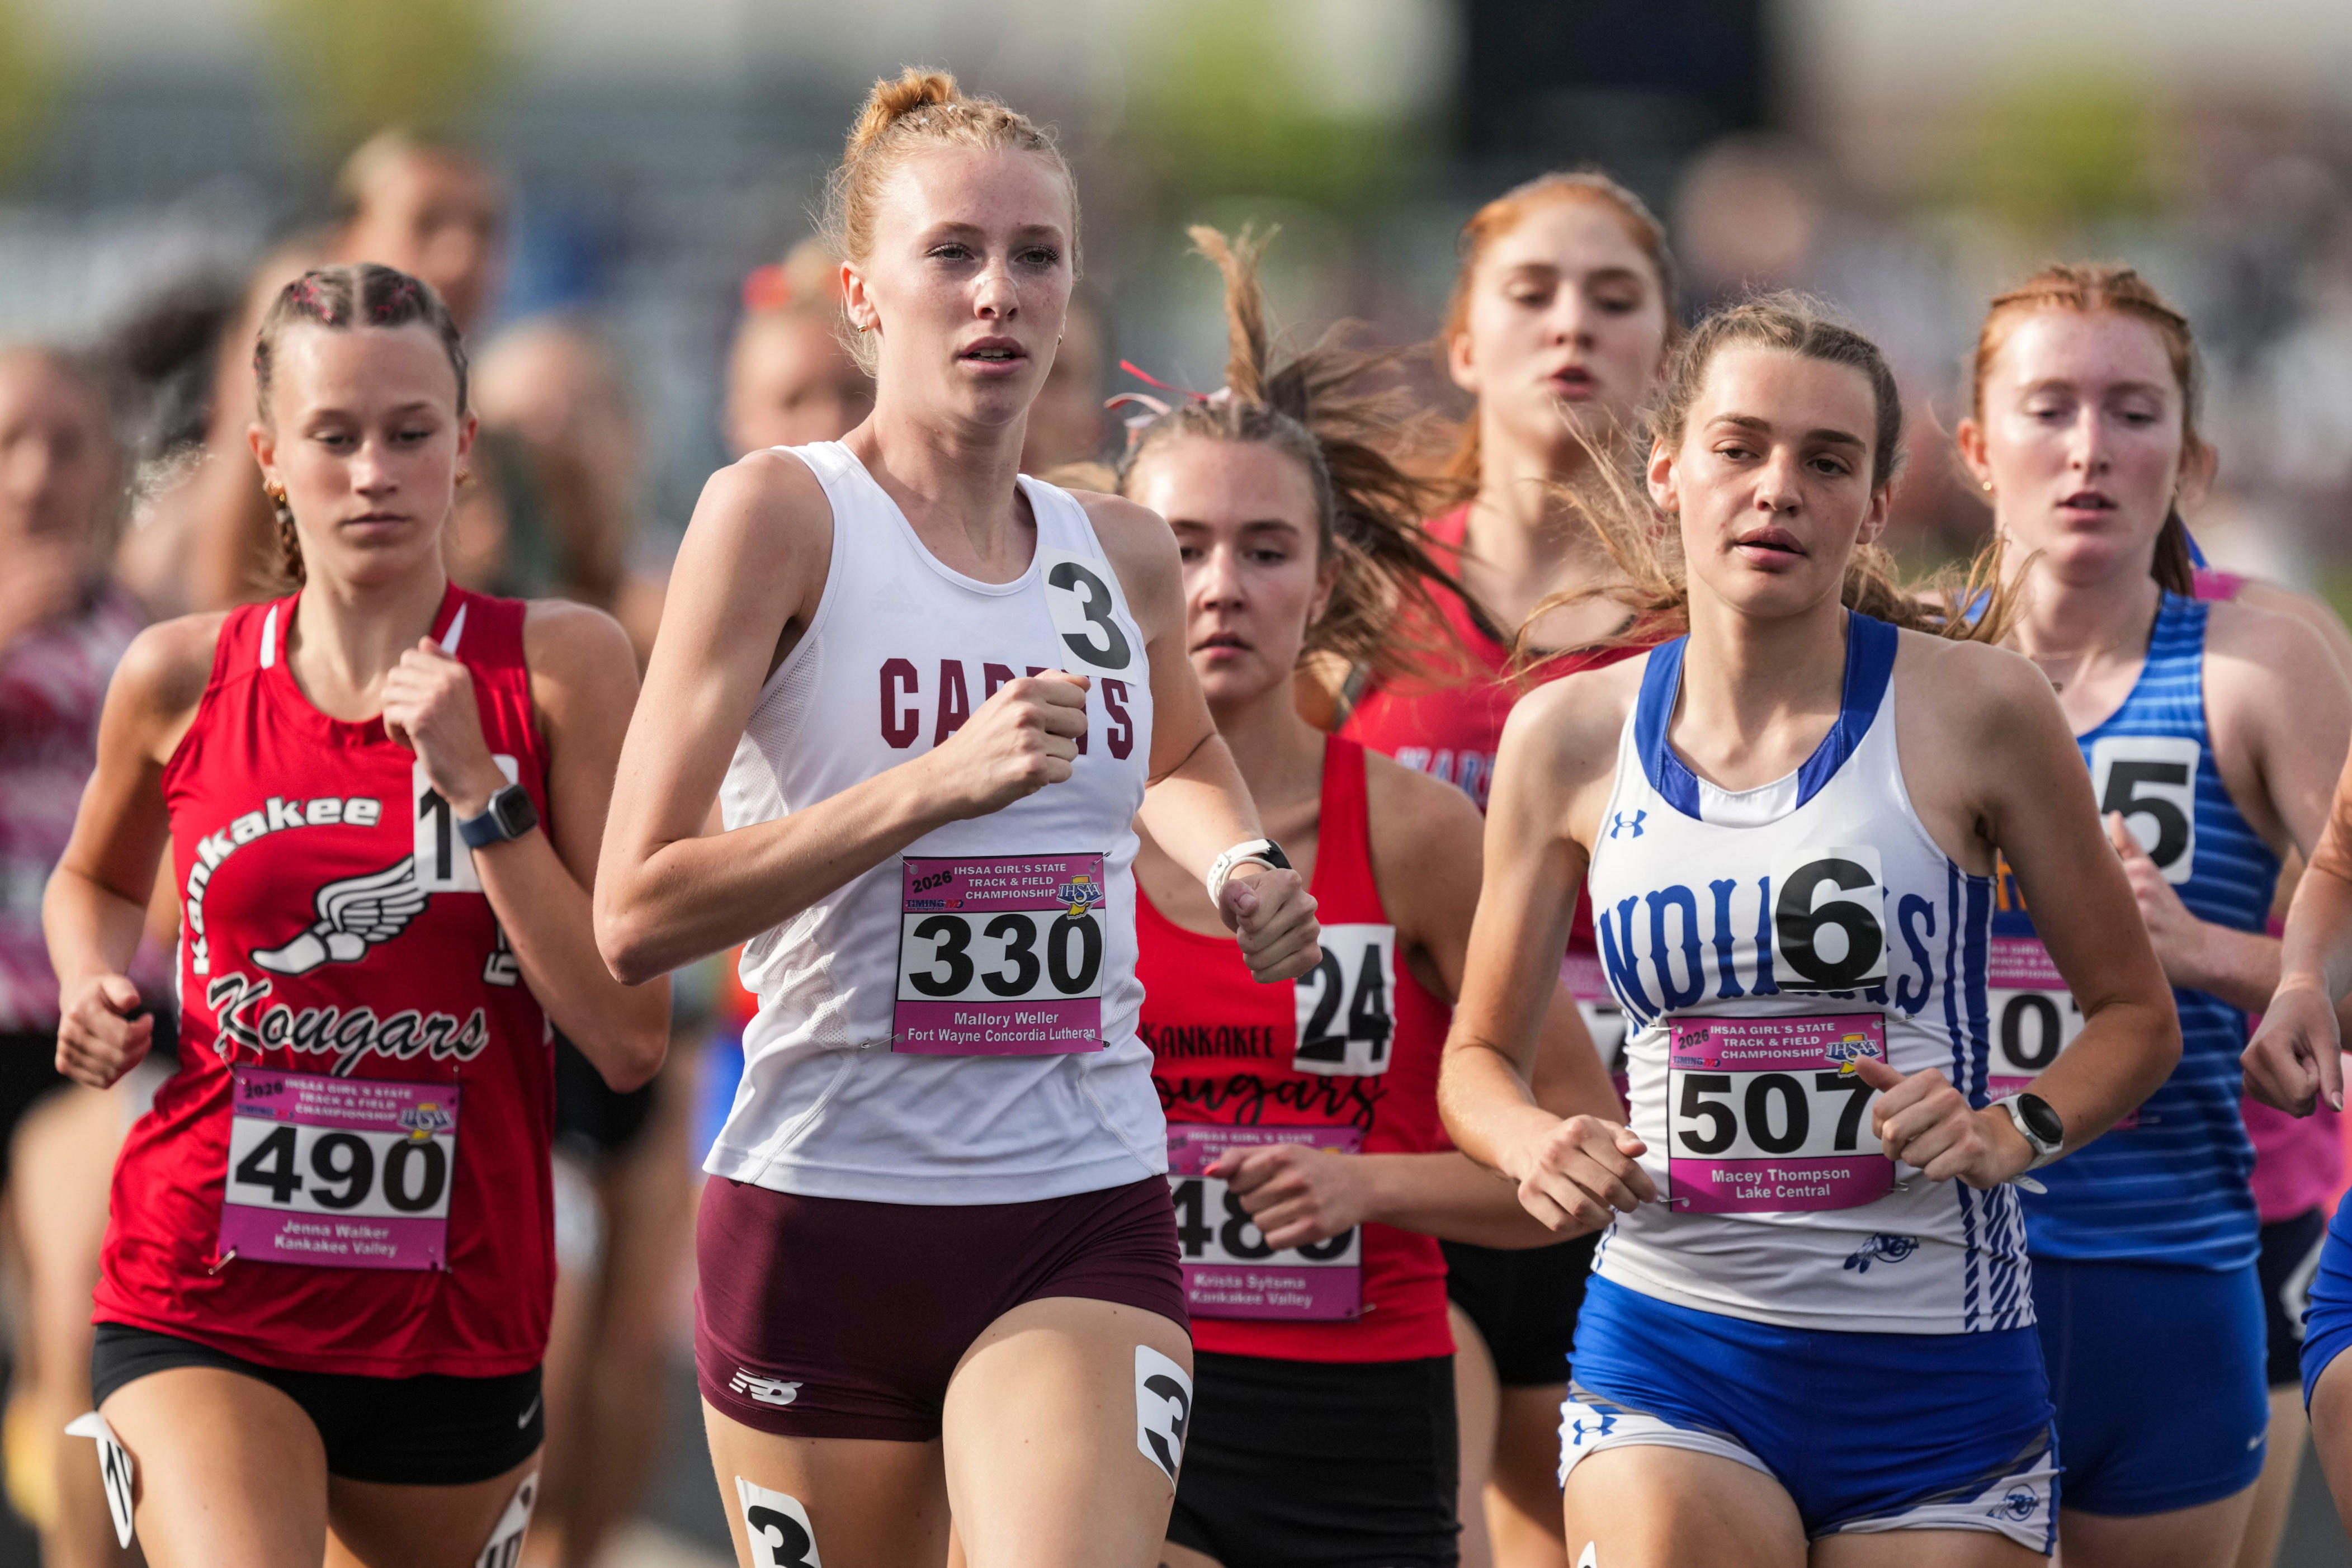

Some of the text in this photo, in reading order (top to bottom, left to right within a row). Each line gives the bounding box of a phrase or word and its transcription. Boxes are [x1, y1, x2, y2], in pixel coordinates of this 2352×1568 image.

[1049, 562, 1131, 670] 3
[2101, 762, 2190, 870] 5
[994, 865, 1031, 873] GIRL'S
[1034, 863, 1066, 872] STATE
[186, 796, 381, 975] Kankakee
[912, 871, 952, 894] 2026
[969, 879, 1006, 887] TRACK
[1022, 876, 1053, 885] FIELD
[1058, 882, 1102, 903] IHSAA
[965, 889, 1056, 899] CHAMPIONSHIP
[1775, 858, 1882, 983] 6
[909, 914, 1102, 997] 330
[1297, 943, 1392, 1062] 24
[206, 971, 489, 1078] Kougars
[954, 1012, 1059, 1028] Mallory Weller
[1710, 1023, 1835, 1035] IHSAA GIRL'S STATE
[908, 1028, 1095, 1042] Fort Wayne Concordia Lutheran
[1142, 1023, 1274, 1059] KANKAKEE
[1678, 1029, 1709, 1050] 2026
[1723, 1036, 1820, 1047] TRACK & FIELD
[1721, 1048, 1824, 1059] CHAMPIONSHIP
[1153, 1073, 1388, 1132] ougars
[1678, 1072, 1878, 1154] 507
[235, 1126, 445, 1212] 490
[1712, 1169, 1850, 1184] Macey Thompson
[1736, 1184, 1830, 1198] Lake Central
[282, 1220, 389, 1239] Jenna Walker
[275, 1235, 397, 1258] Kankakee Valley
[1189, 1291, 1313, 1309] Kankakee Valley
[1143, 1374, 1189, 1472] 3
